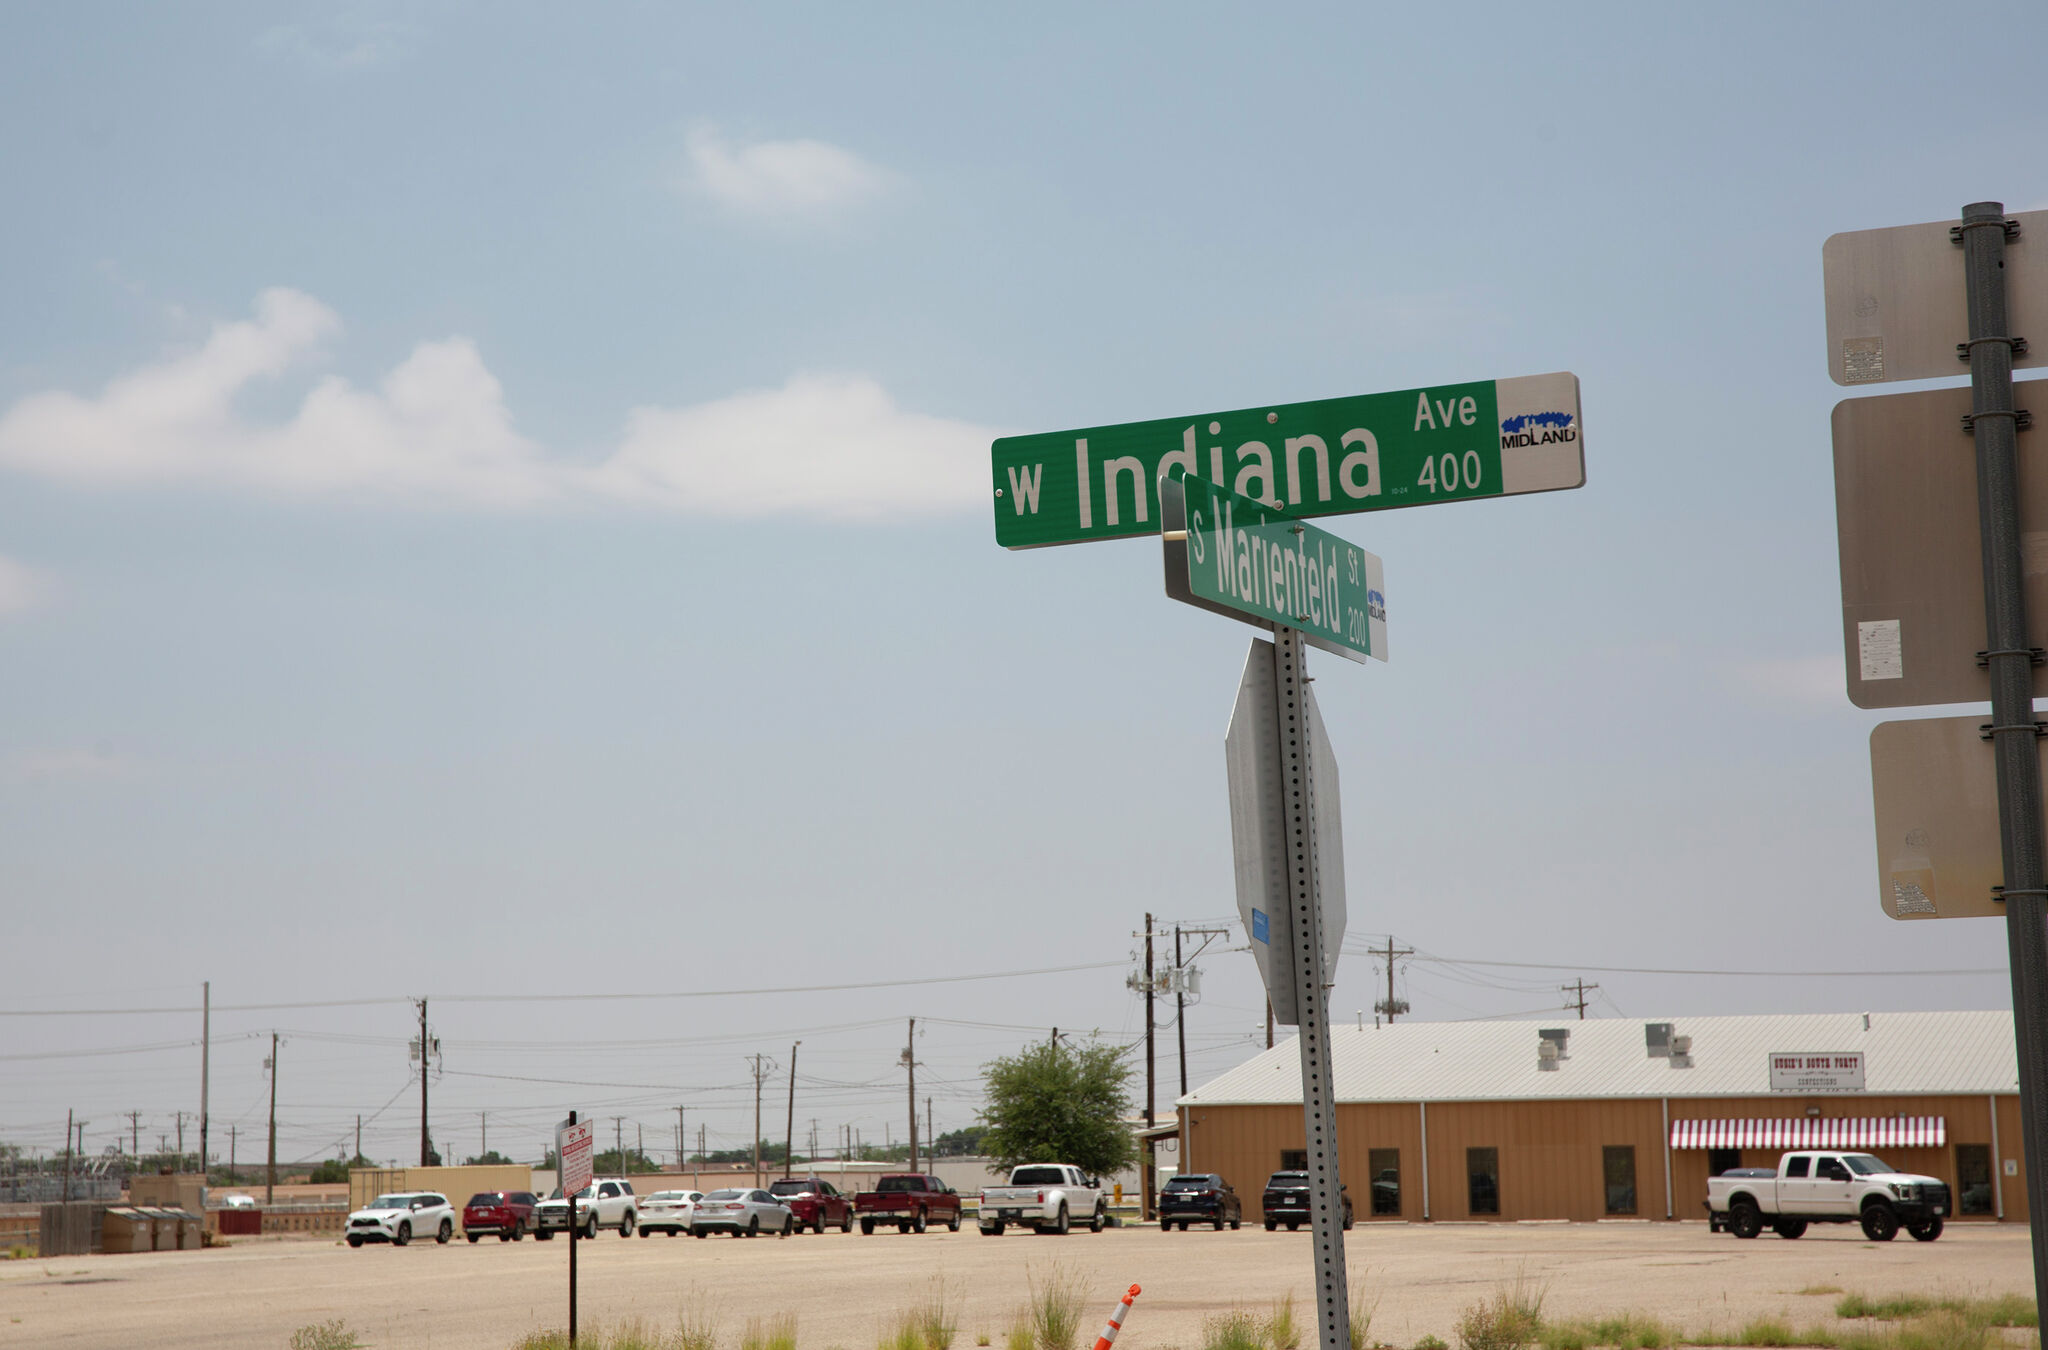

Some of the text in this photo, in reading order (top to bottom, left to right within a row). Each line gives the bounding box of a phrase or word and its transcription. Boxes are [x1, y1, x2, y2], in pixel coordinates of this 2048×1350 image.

[1007, 391, 1478, 529] W Indiana Ave
[1501, 428, 1576, 449] MIDLAND
[1417, 450, 1482, 494] 400
[1192, 495, 1360, 635] S Marienfeld St
[1347, 606, 1366, 648] 200
[1806, 1057, 1831, 1069] SOUTH
